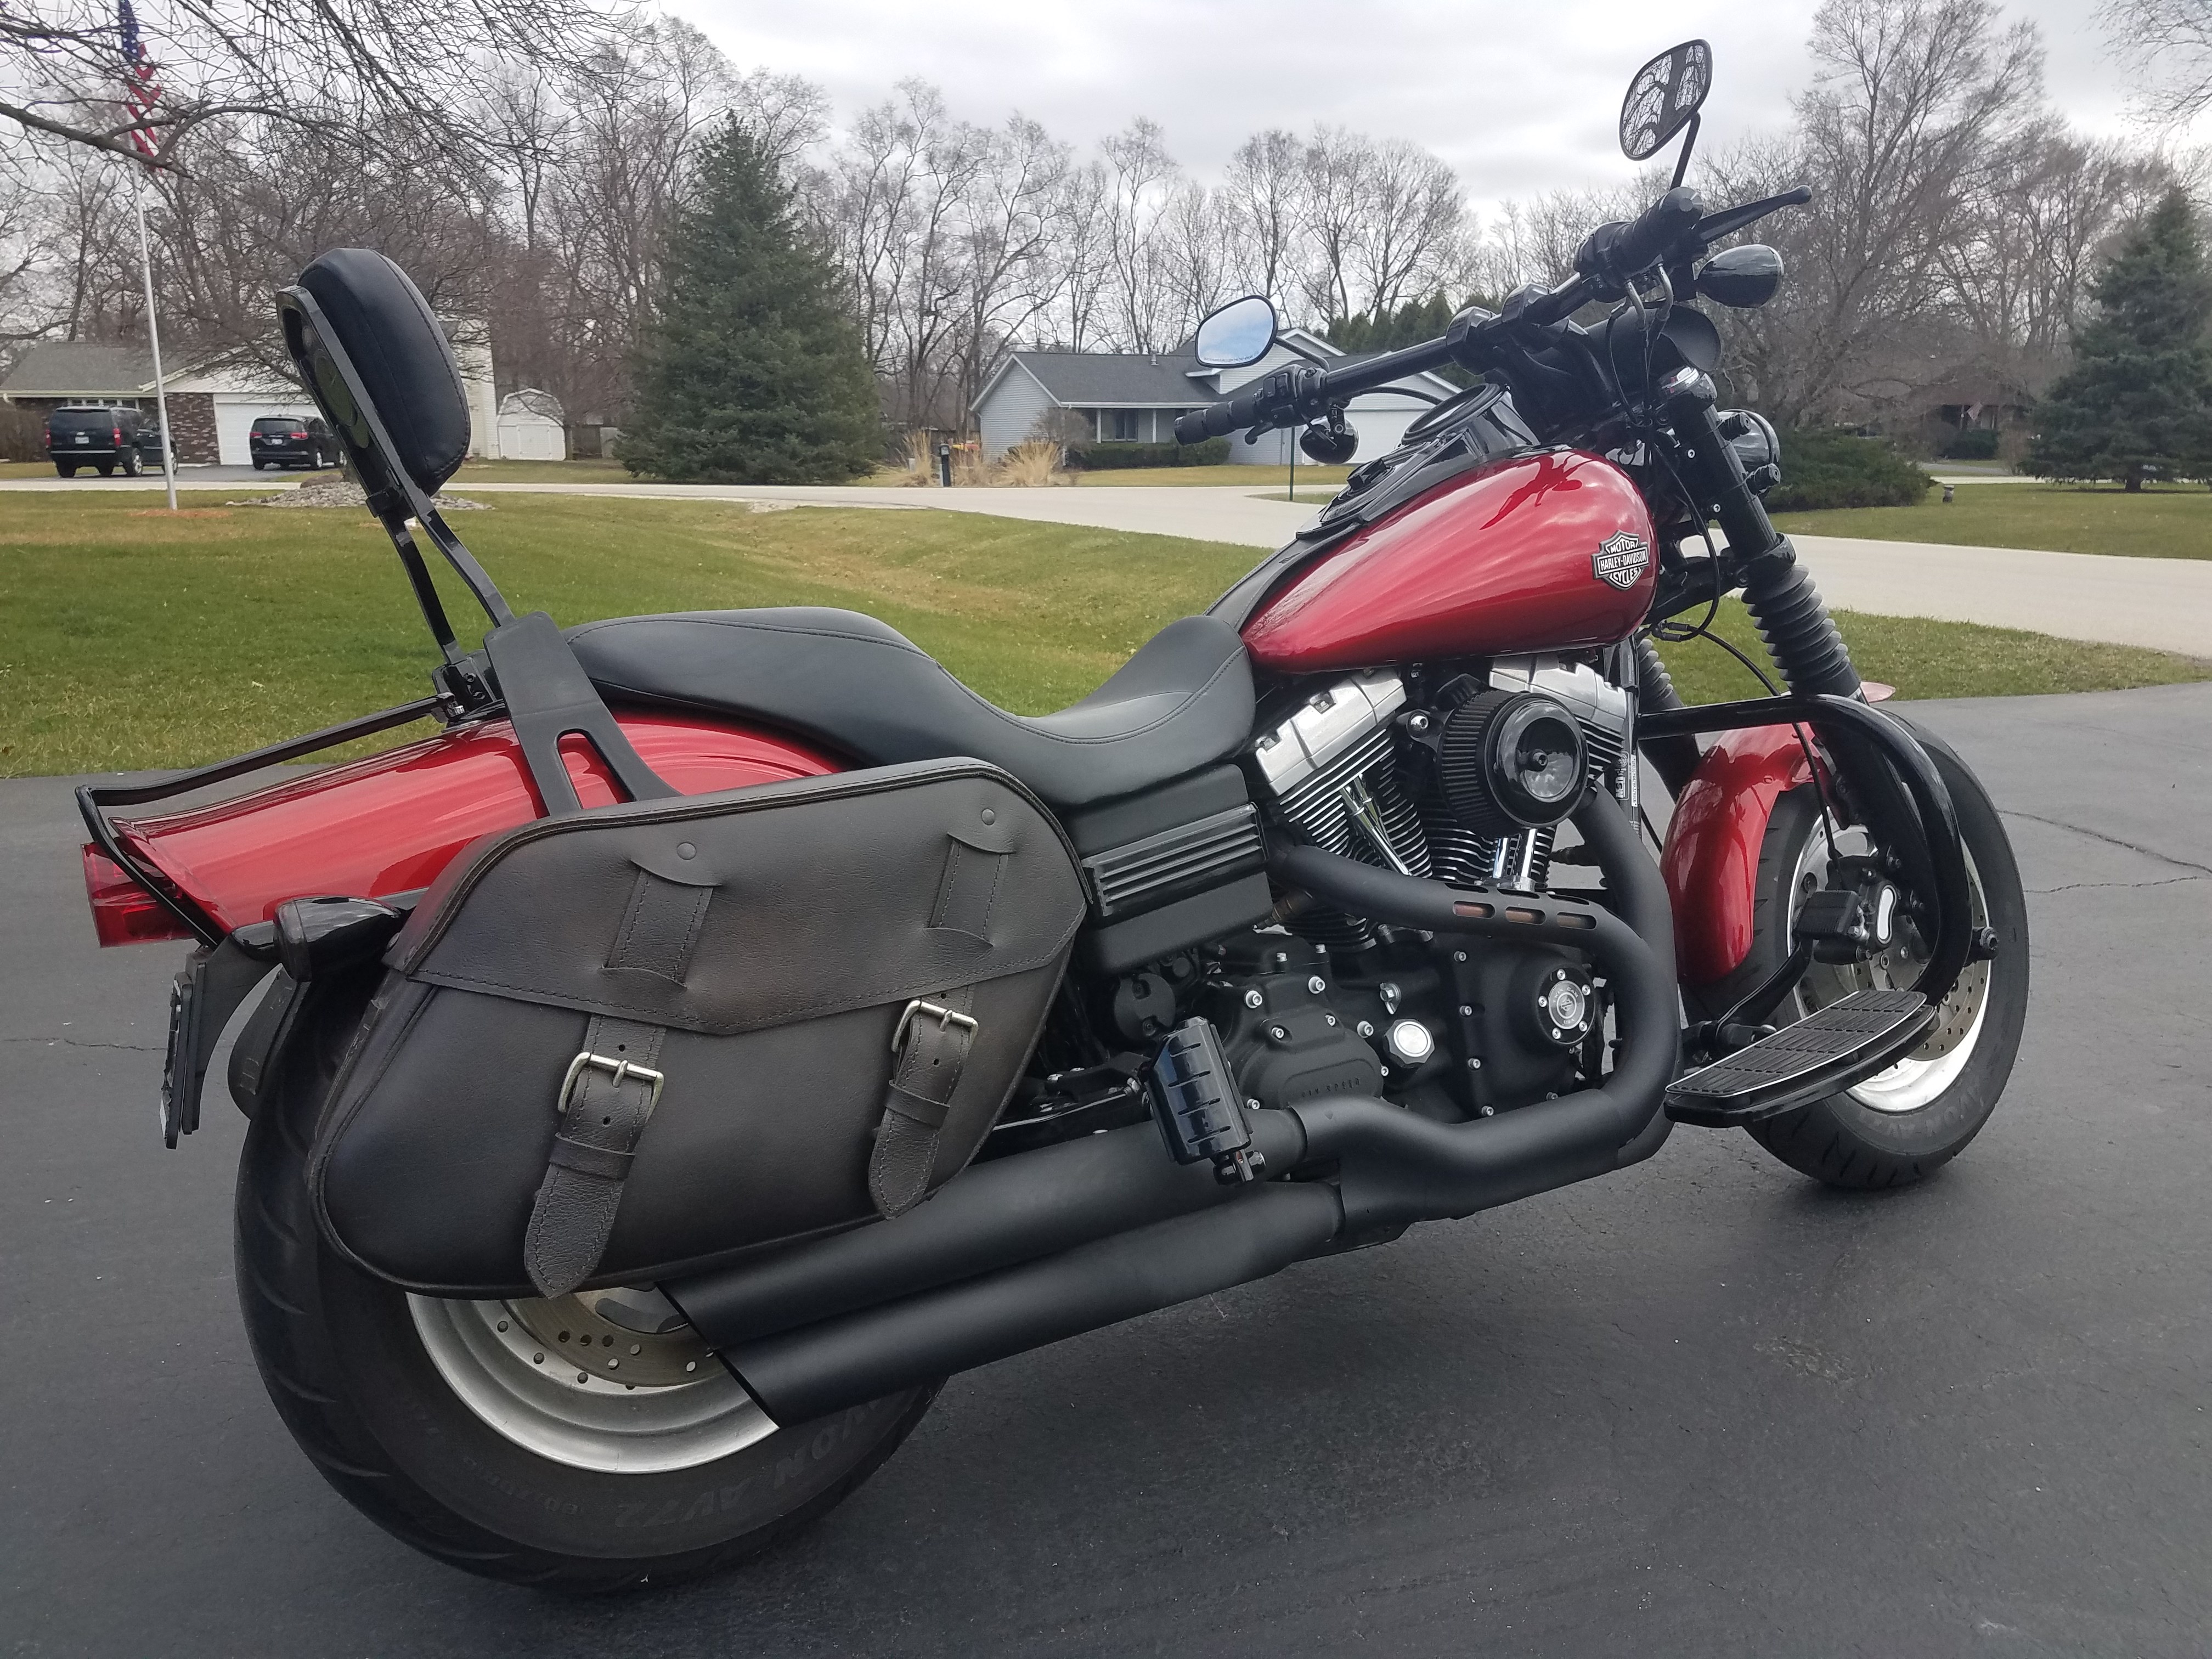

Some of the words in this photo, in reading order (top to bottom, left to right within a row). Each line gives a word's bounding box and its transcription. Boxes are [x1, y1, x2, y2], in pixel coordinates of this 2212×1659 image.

[1610, 539, 1635, 553] MOTOR
[1600, 550, 1646, 571] HARLEY-DAVIDSON
[1612, 568, 1638, 584] CYCLES
[1567, 987, 1579, 998] CAM
